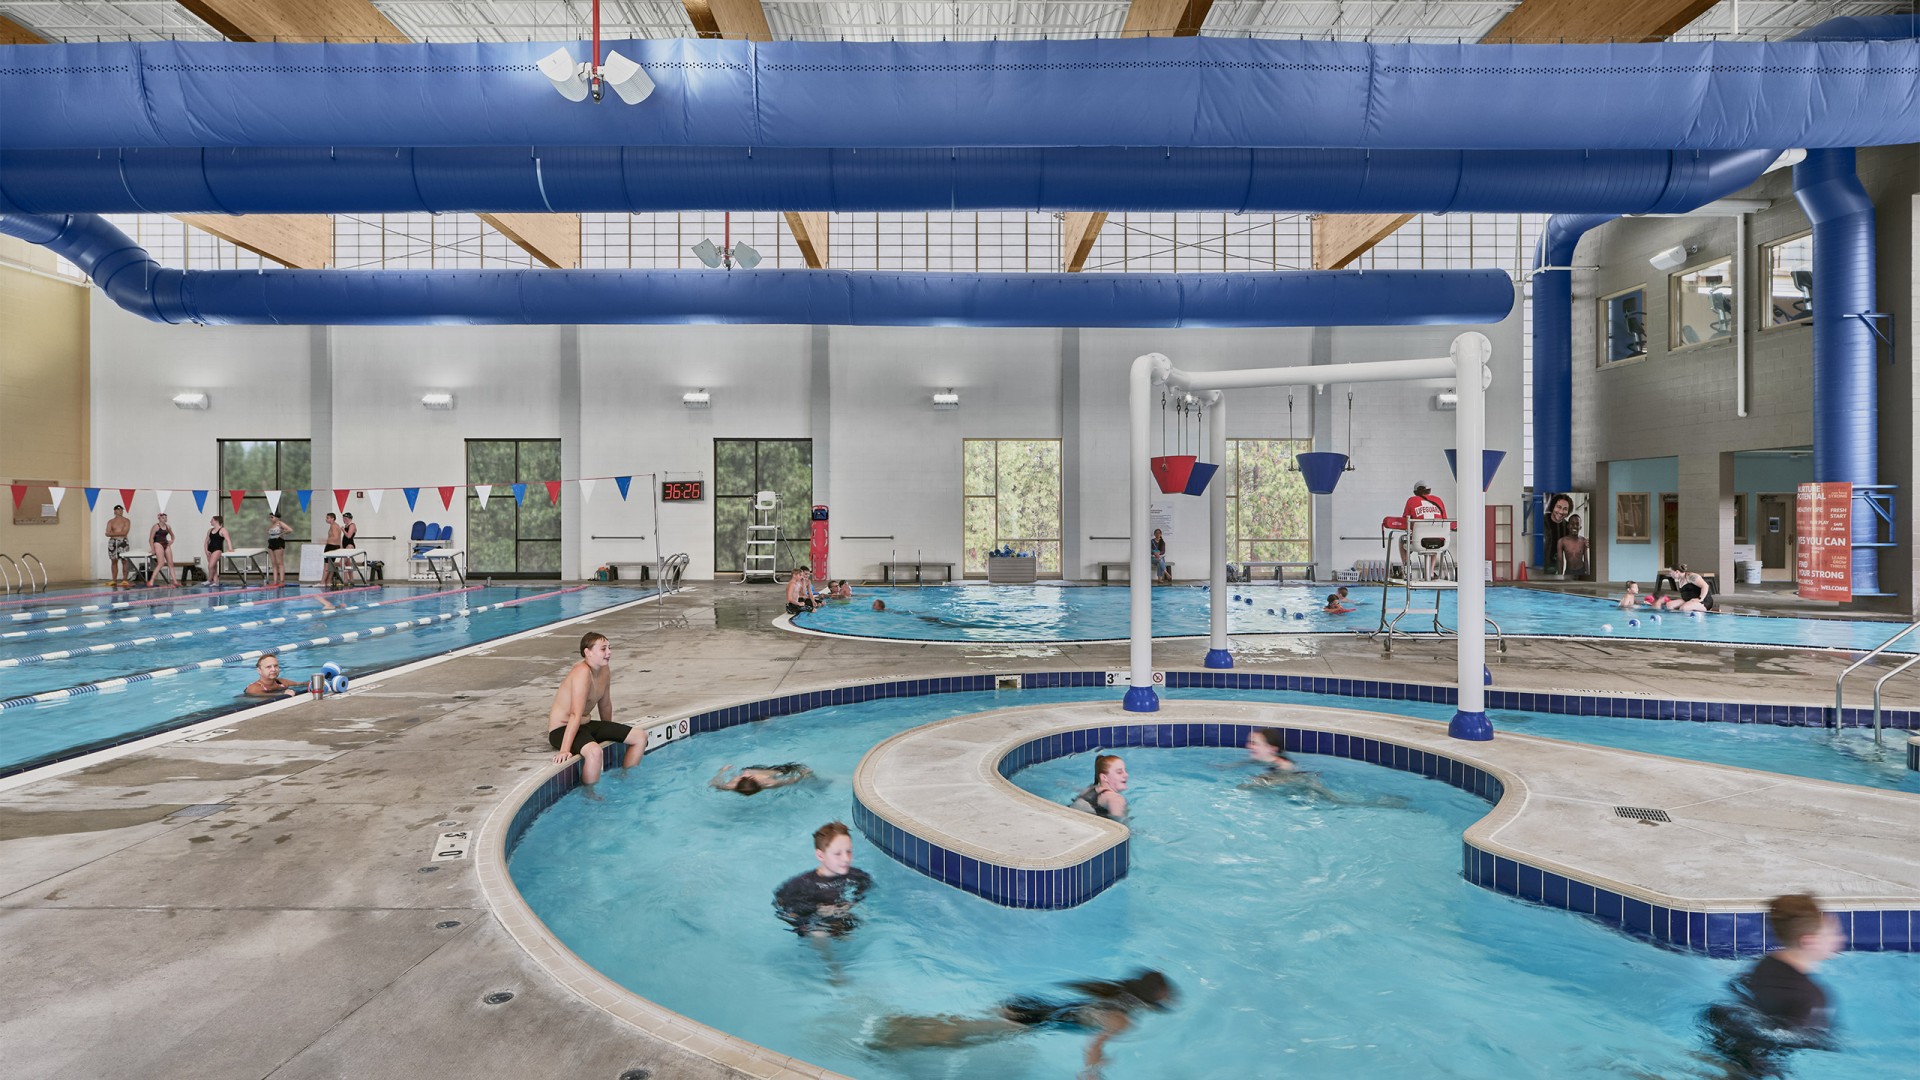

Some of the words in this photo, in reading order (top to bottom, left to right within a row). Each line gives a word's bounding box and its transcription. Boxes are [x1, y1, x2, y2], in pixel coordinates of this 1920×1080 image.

[1806, 536, 1822, 546] YOU
[1824, 537, 1846, 546] CAN
[1798, 569, 1810, 577] YOUR
[1811, 570, 1844, 579] STRONG
